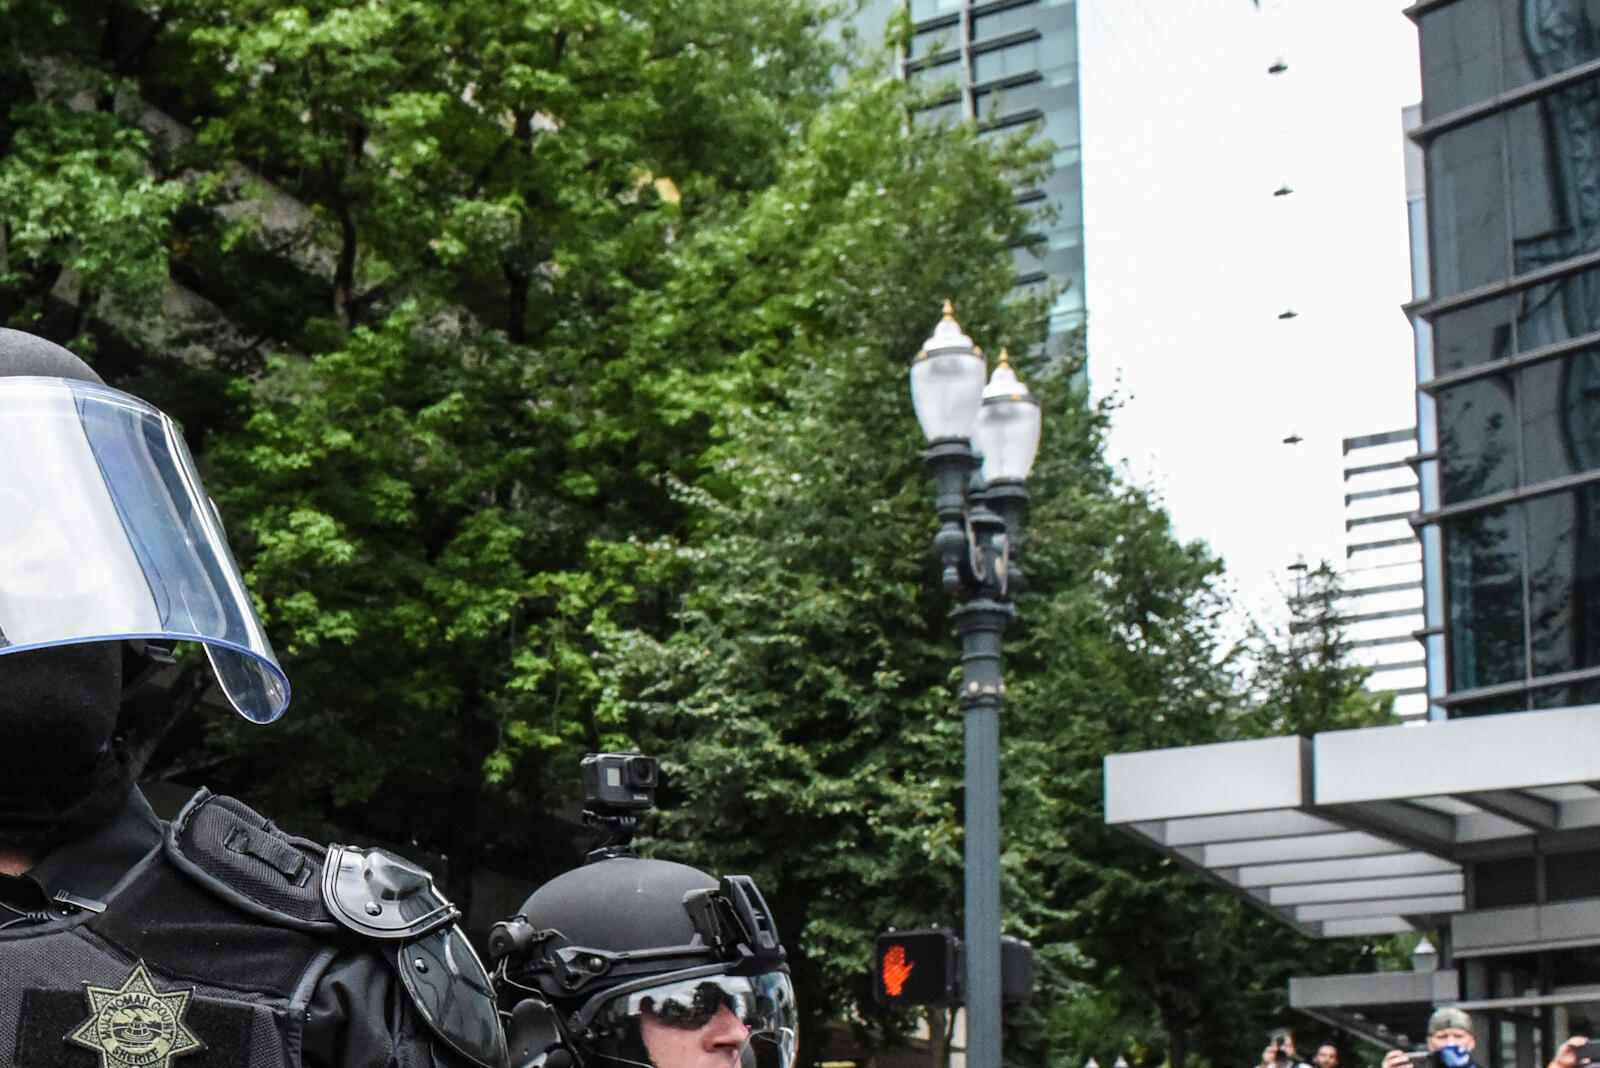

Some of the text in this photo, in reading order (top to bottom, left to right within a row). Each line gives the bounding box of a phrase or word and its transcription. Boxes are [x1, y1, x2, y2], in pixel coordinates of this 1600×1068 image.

[100, 994, 175, 1040] MULTNOMAH COUNTY
[112, 1046, 159, 1064] SHERIFF
